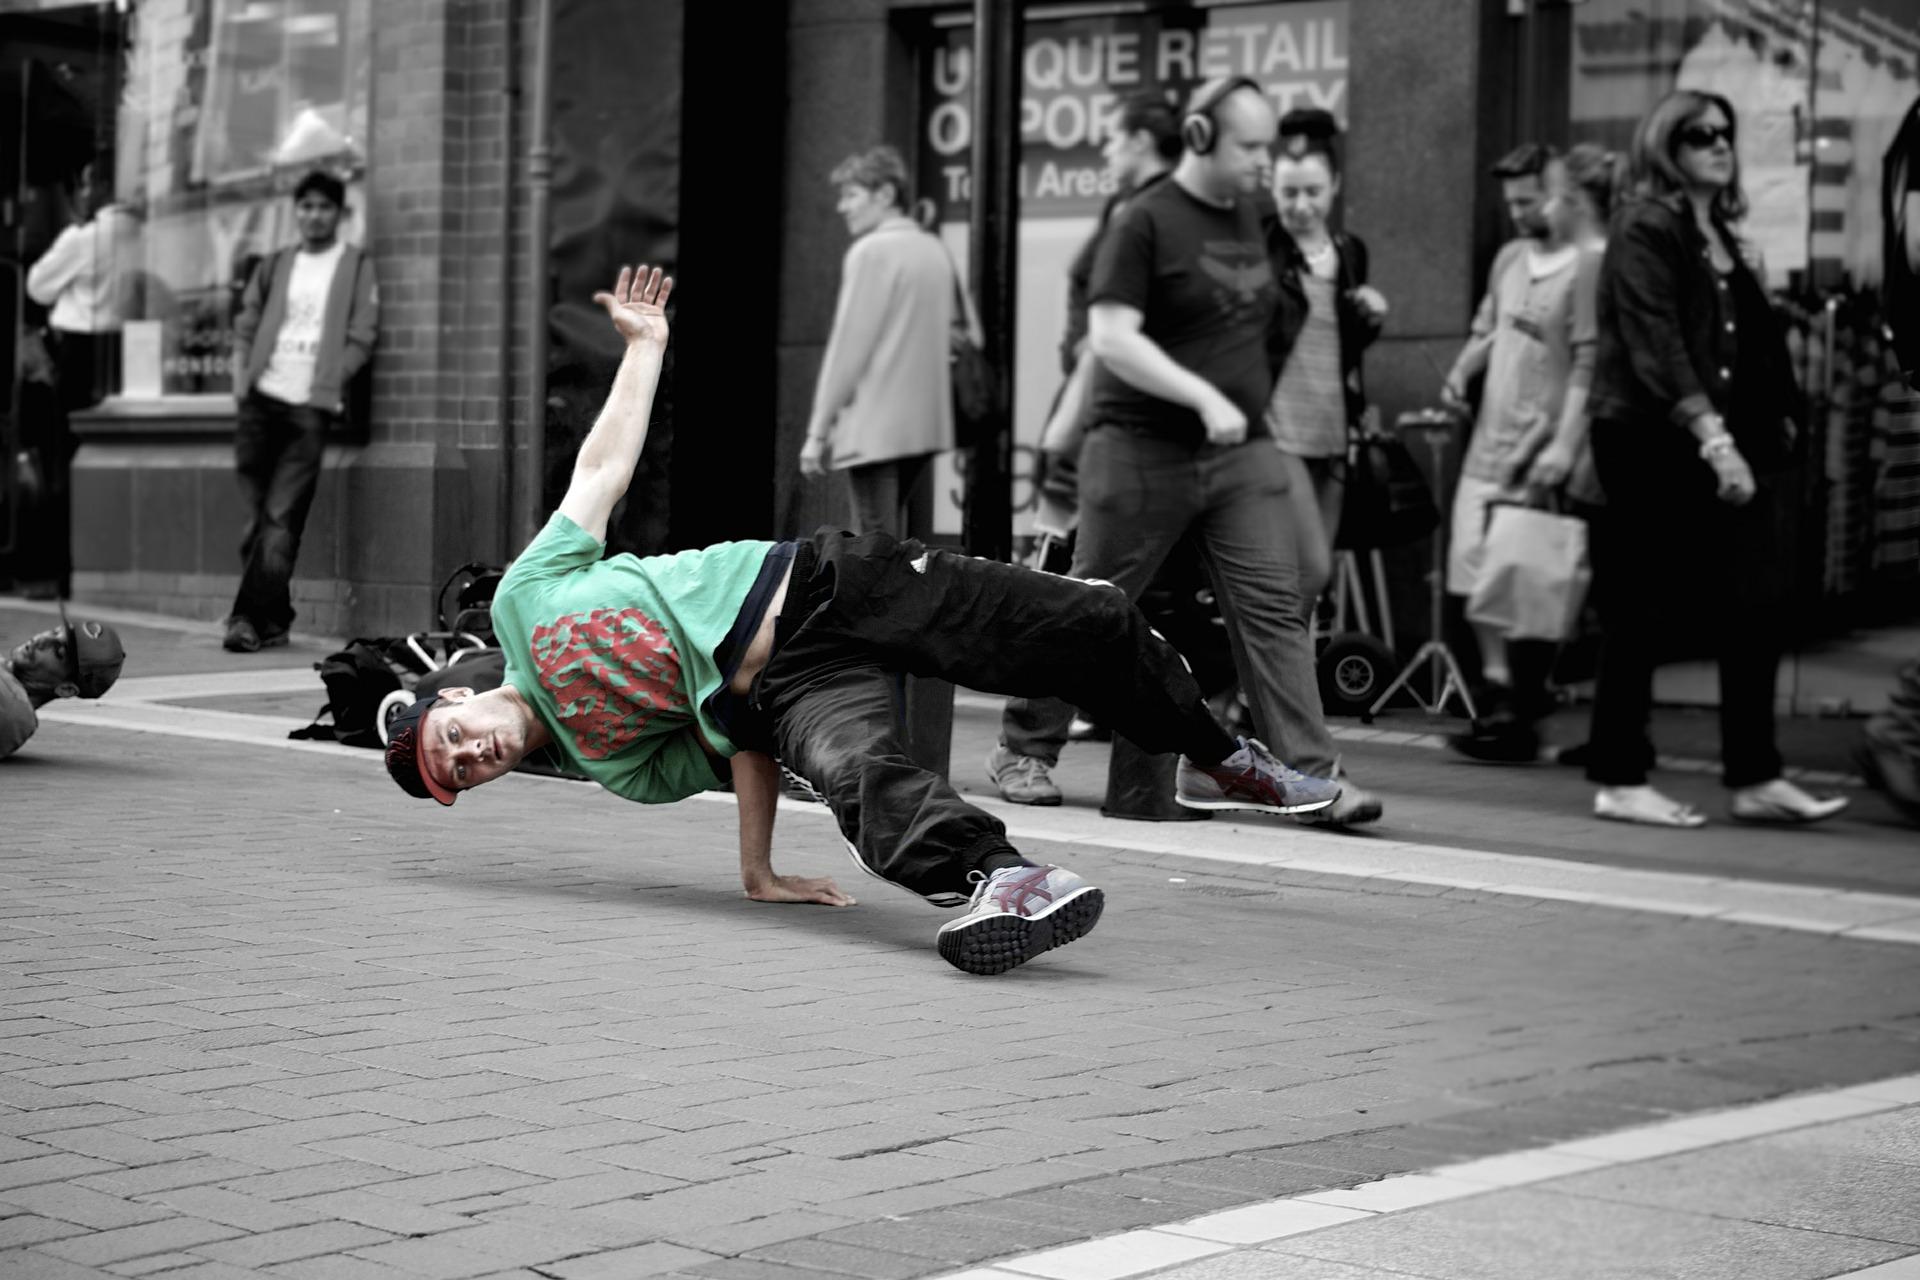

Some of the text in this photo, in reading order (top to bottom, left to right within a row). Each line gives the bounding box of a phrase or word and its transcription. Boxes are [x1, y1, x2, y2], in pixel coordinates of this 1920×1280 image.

[934, 18, 1348, 94] UQUE RETAIL
[1036, 161, 1119, 198] Area
